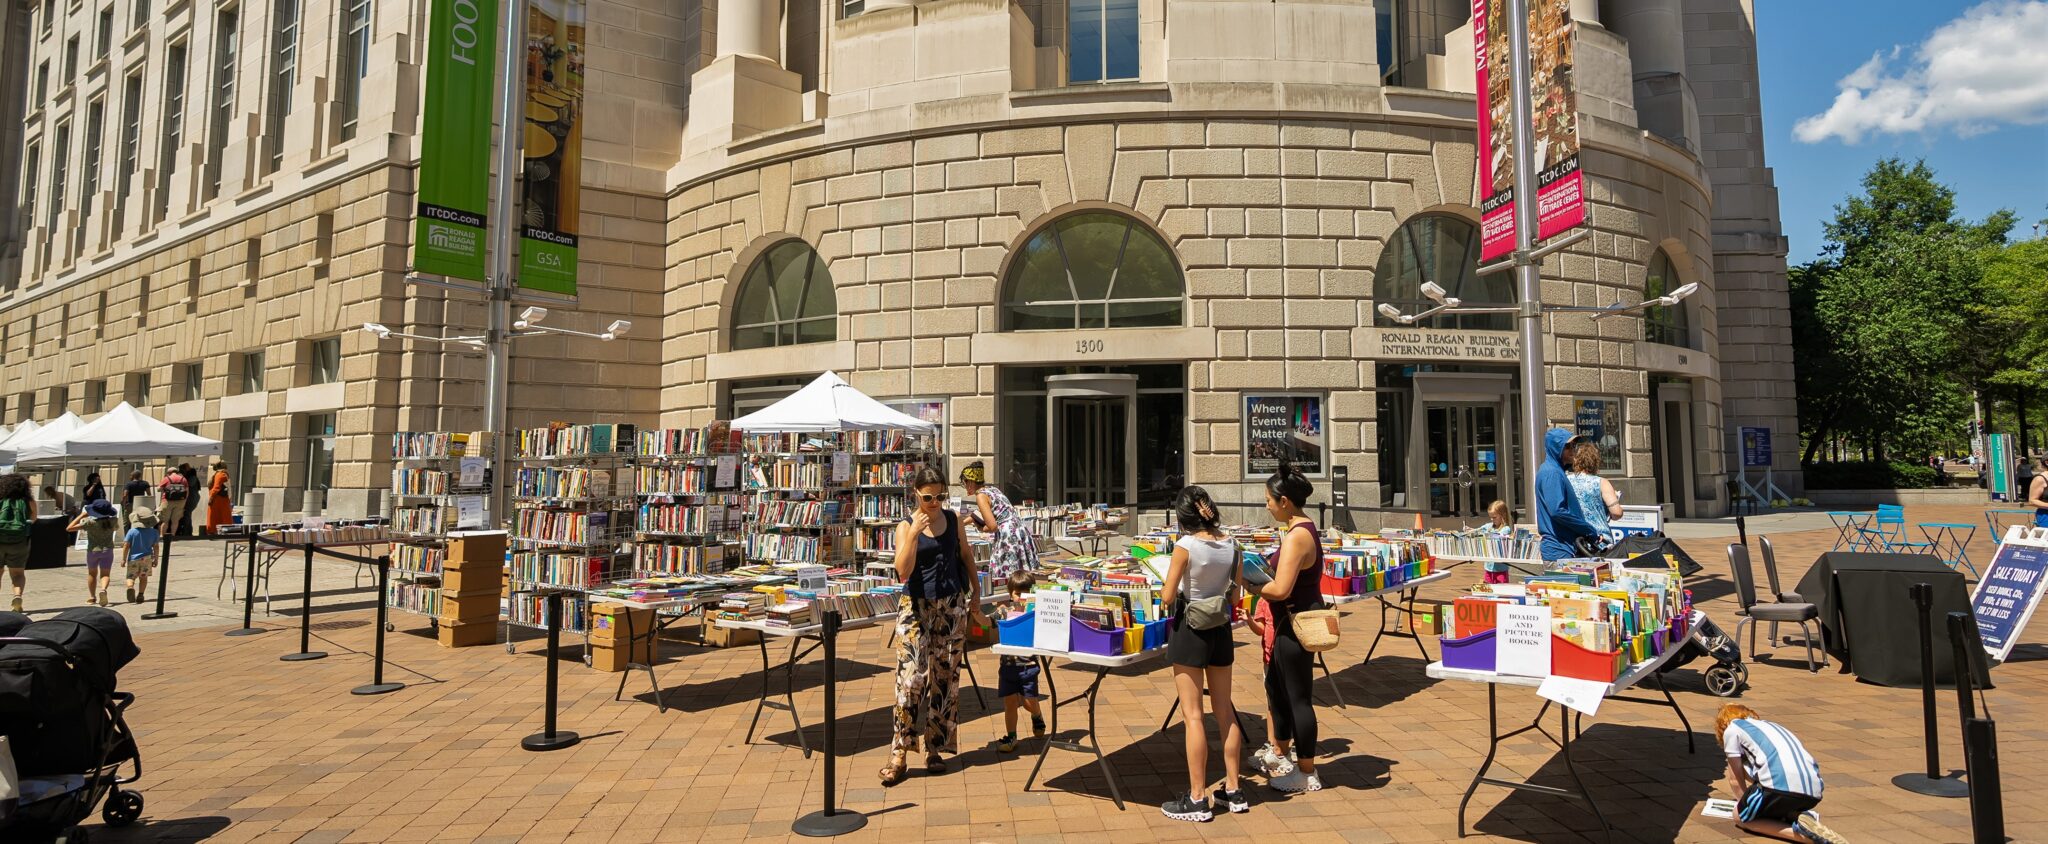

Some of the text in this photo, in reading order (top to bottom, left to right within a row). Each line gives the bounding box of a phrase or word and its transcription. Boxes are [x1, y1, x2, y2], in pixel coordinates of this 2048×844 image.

[426, 206, 480, 226] ITCDC.com
[527, 227, 573, 245] ITCDC.com
[537, 252, 561, 266] GSA
[1381, 333, 1421, 343] RONALD
[1426, 334, 1465, 345] REAGAN
[1470, 335, 1510, 347] BUILDING
[1076, 339, 1104, 354] 1300
[1382, 345, 1460, 357] INTERNATIONAL
[1465, 346, 1496, 358] TRADE
[1251, 403, 1287, 414] Where
[1578, 406, 1599, 415] Where
[1251, 416, 1287, 426] Events
[1578, 417, 1602, 426] Leaders
[1251, 429, 1288, 439] Matter
[1578, 428, 1594, 437] Lead
[1993, 566, 2038, 584] SALE TODAY
[1040, 610, 1066, 618] PICTURE
[1509, 613, 1539, 621] BOARD
[1997, 609, 2011, 619] LESS
[1504, 629, 1544, 638] PICTURE
[1509, 638, 1539, 646] BOOKS
